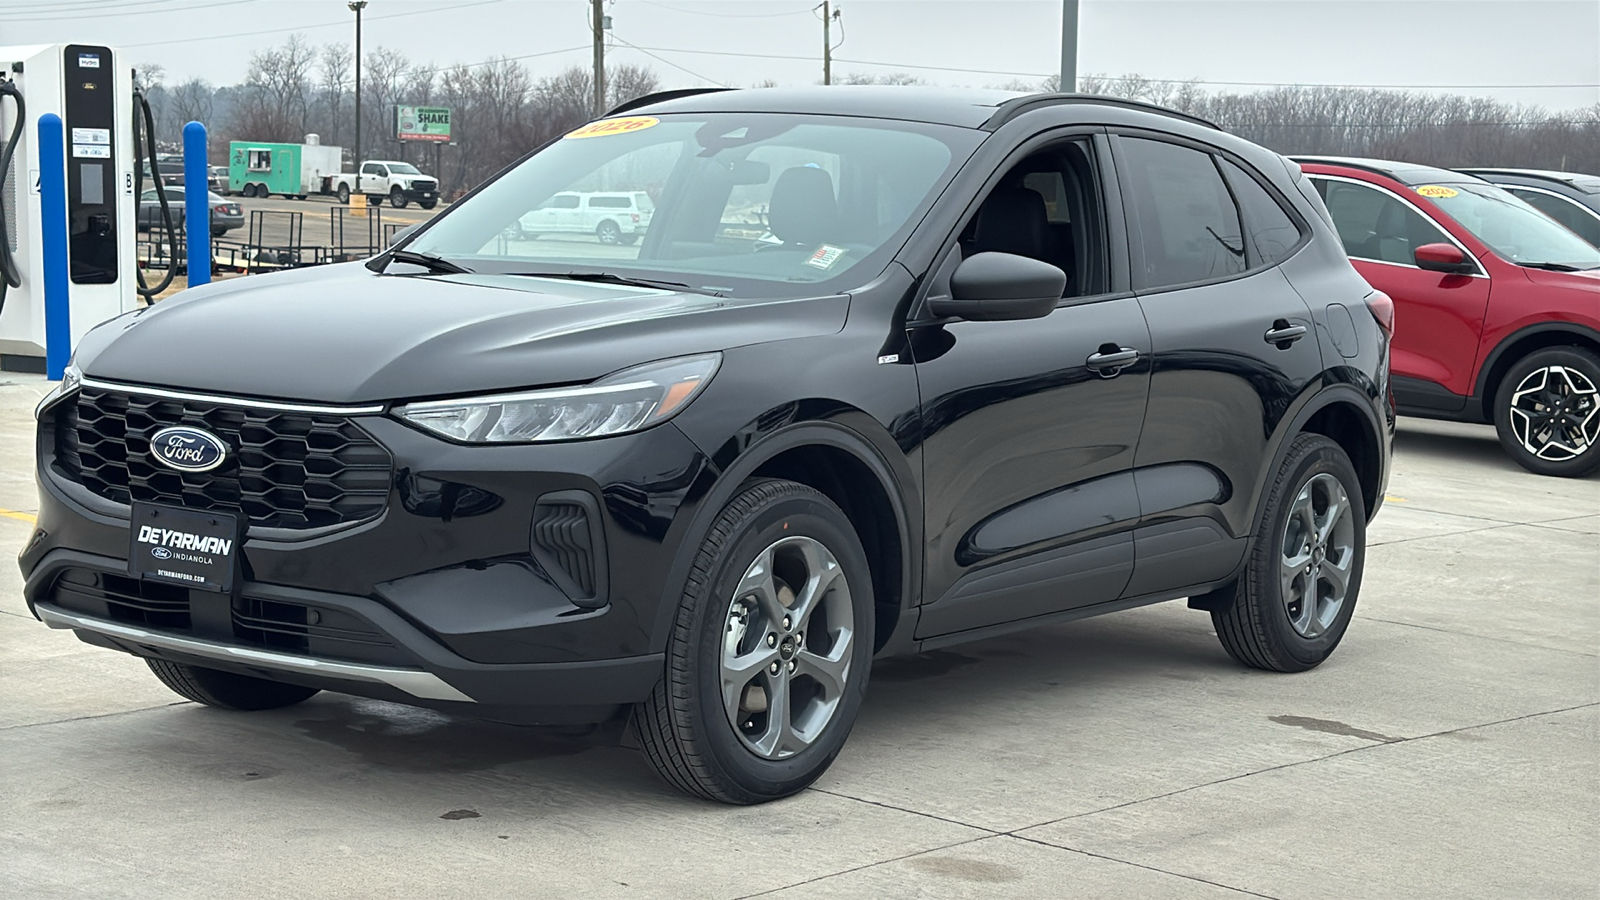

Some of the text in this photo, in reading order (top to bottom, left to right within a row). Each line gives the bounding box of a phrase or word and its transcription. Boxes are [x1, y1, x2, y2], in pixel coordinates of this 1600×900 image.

[418, 114, 449, 123] SHAKE
[572, 119, 651, 136] 2026
[164, 435, 205, 463] Ford
[138, 525, 232, 555] DEYARMAN
[154, 549, 213, 565] Ford INDIANOLA
[157, 569, 205, 583] DEYARMANFORD.COM
